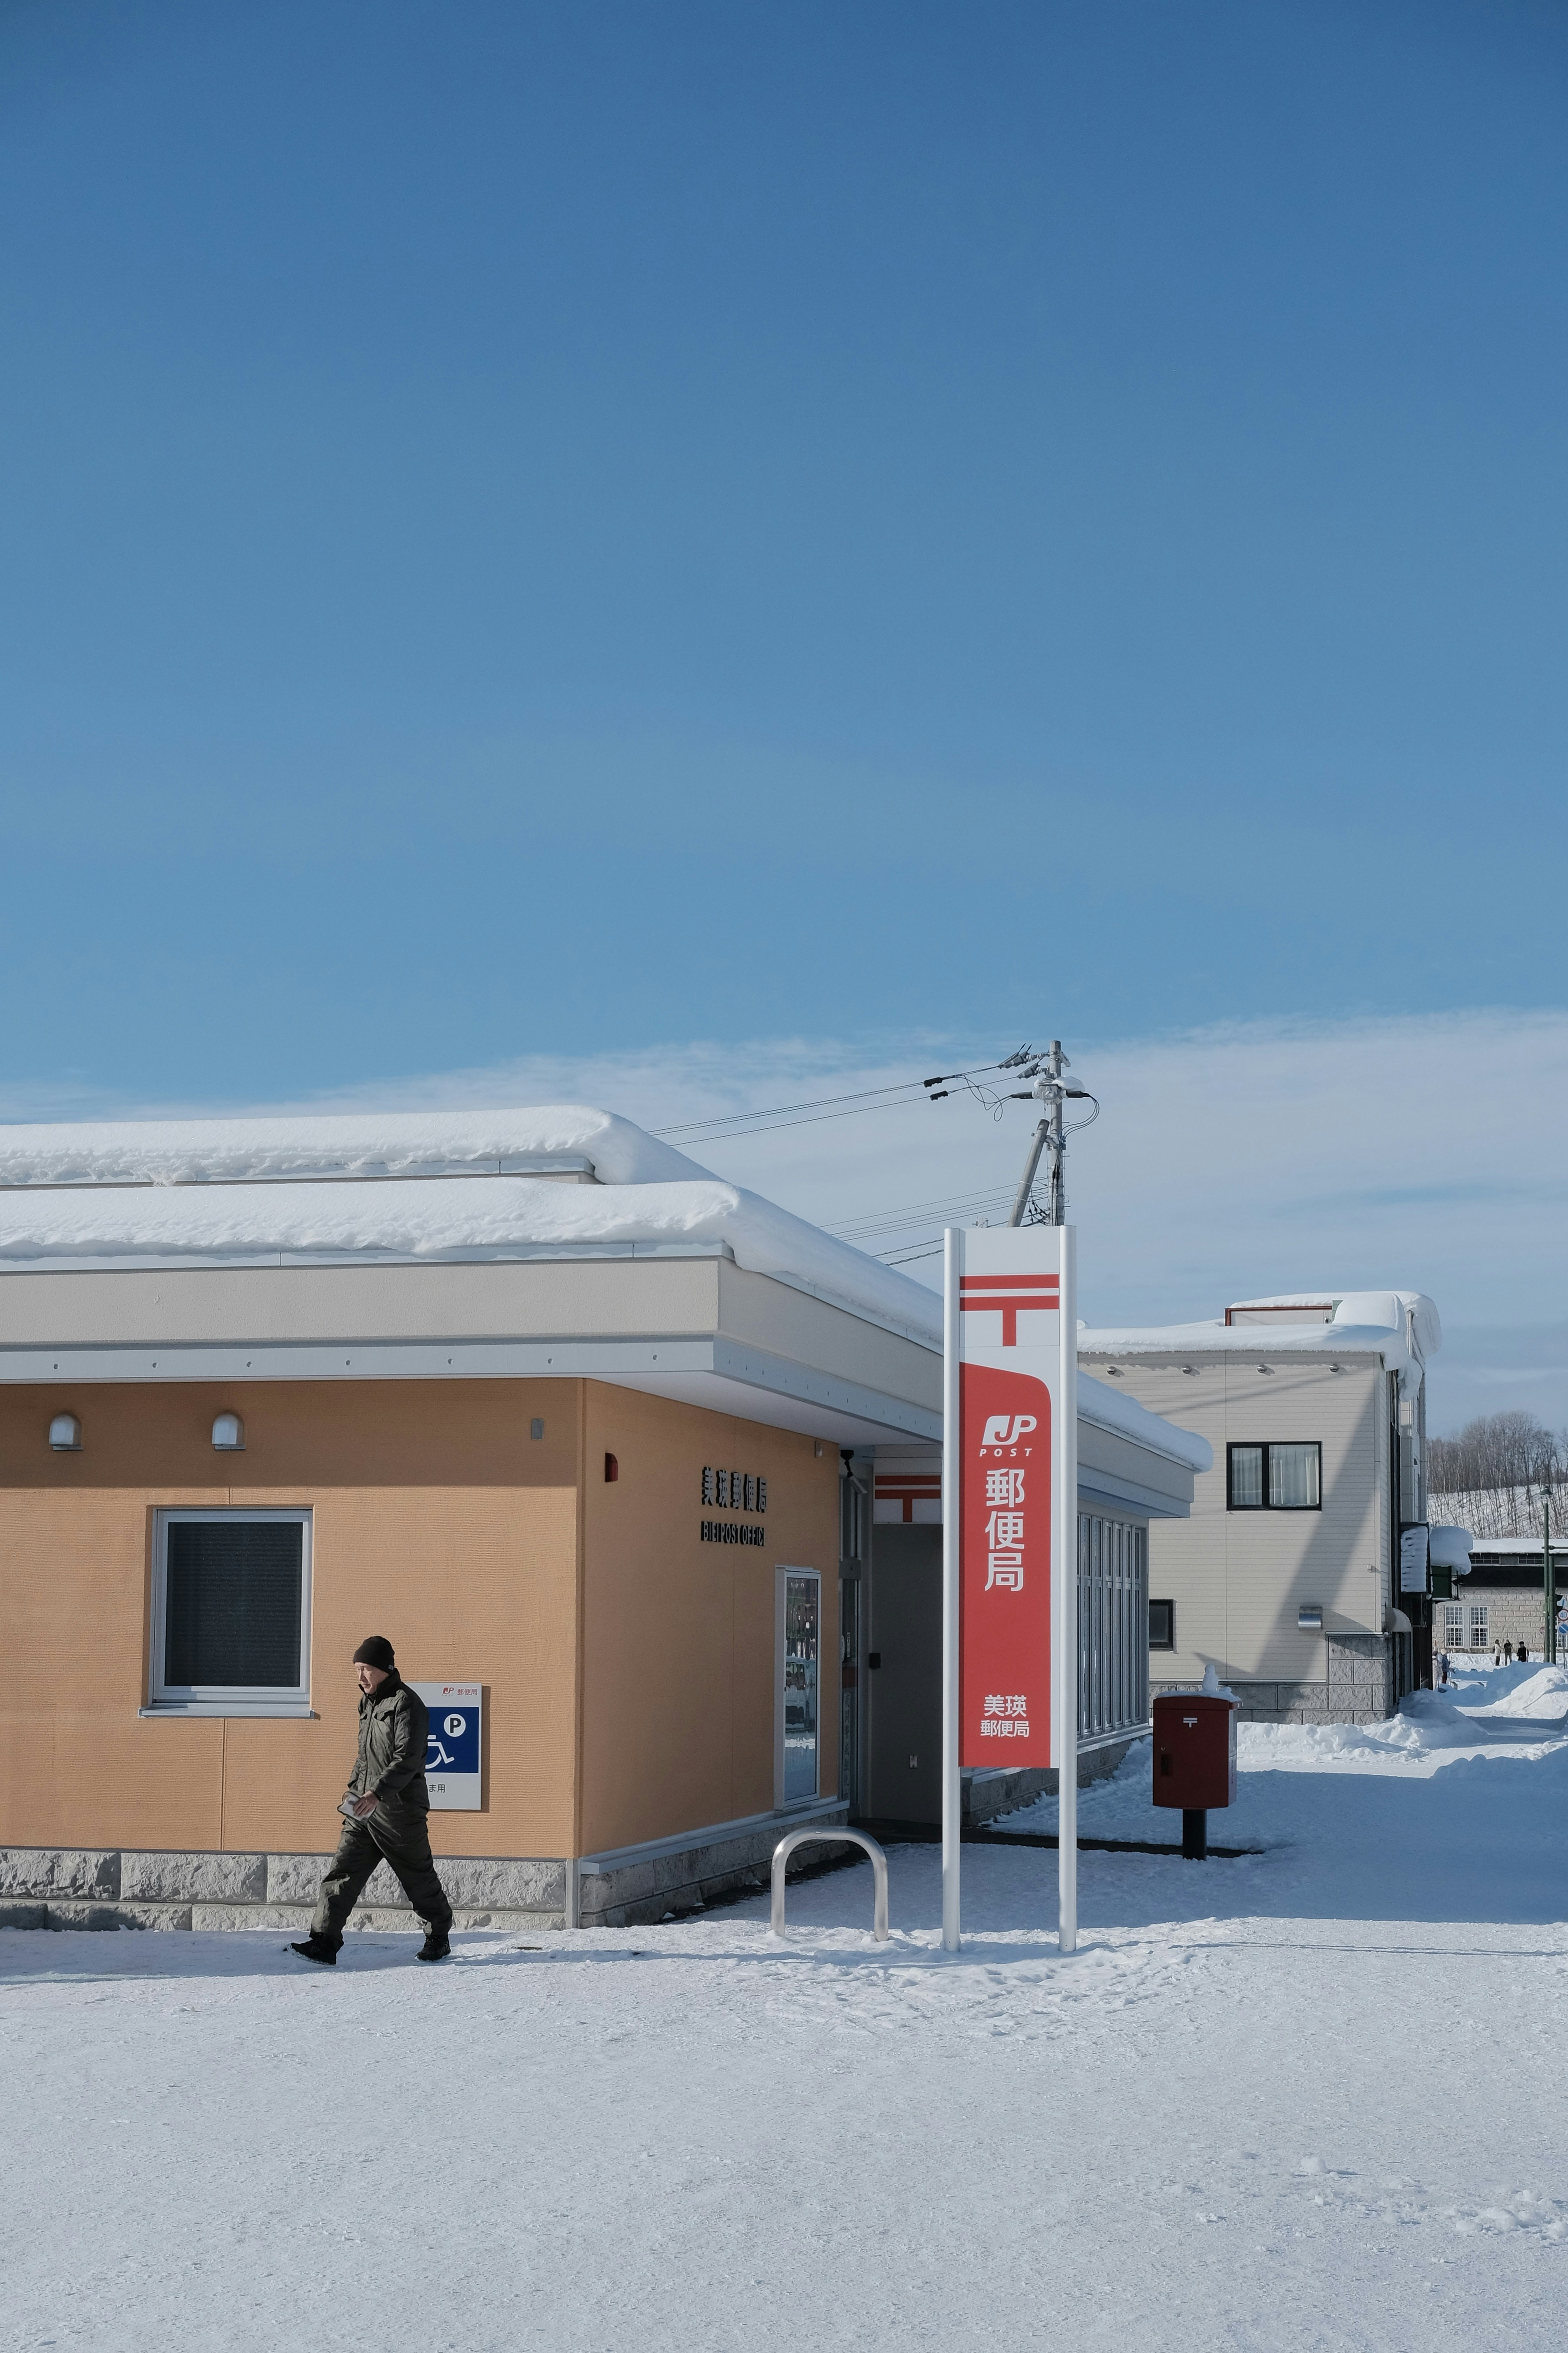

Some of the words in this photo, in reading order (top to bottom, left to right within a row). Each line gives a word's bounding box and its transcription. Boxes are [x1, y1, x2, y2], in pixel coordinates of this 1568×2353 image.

[982, 1415, 1037, 1445] JP
[980, 1448, 1032, 1457] POST
[702, 1521, 719, 1542] BIEI
[719, 1523, 740, 1543] POST
[985, 1468, 1025, 1591] 郵便局
[984, 1695, 1026, 1717] 美瑛
[450, 1718, 461, 1733] P
[980, 1720, 1030, 1737] 郵便局
